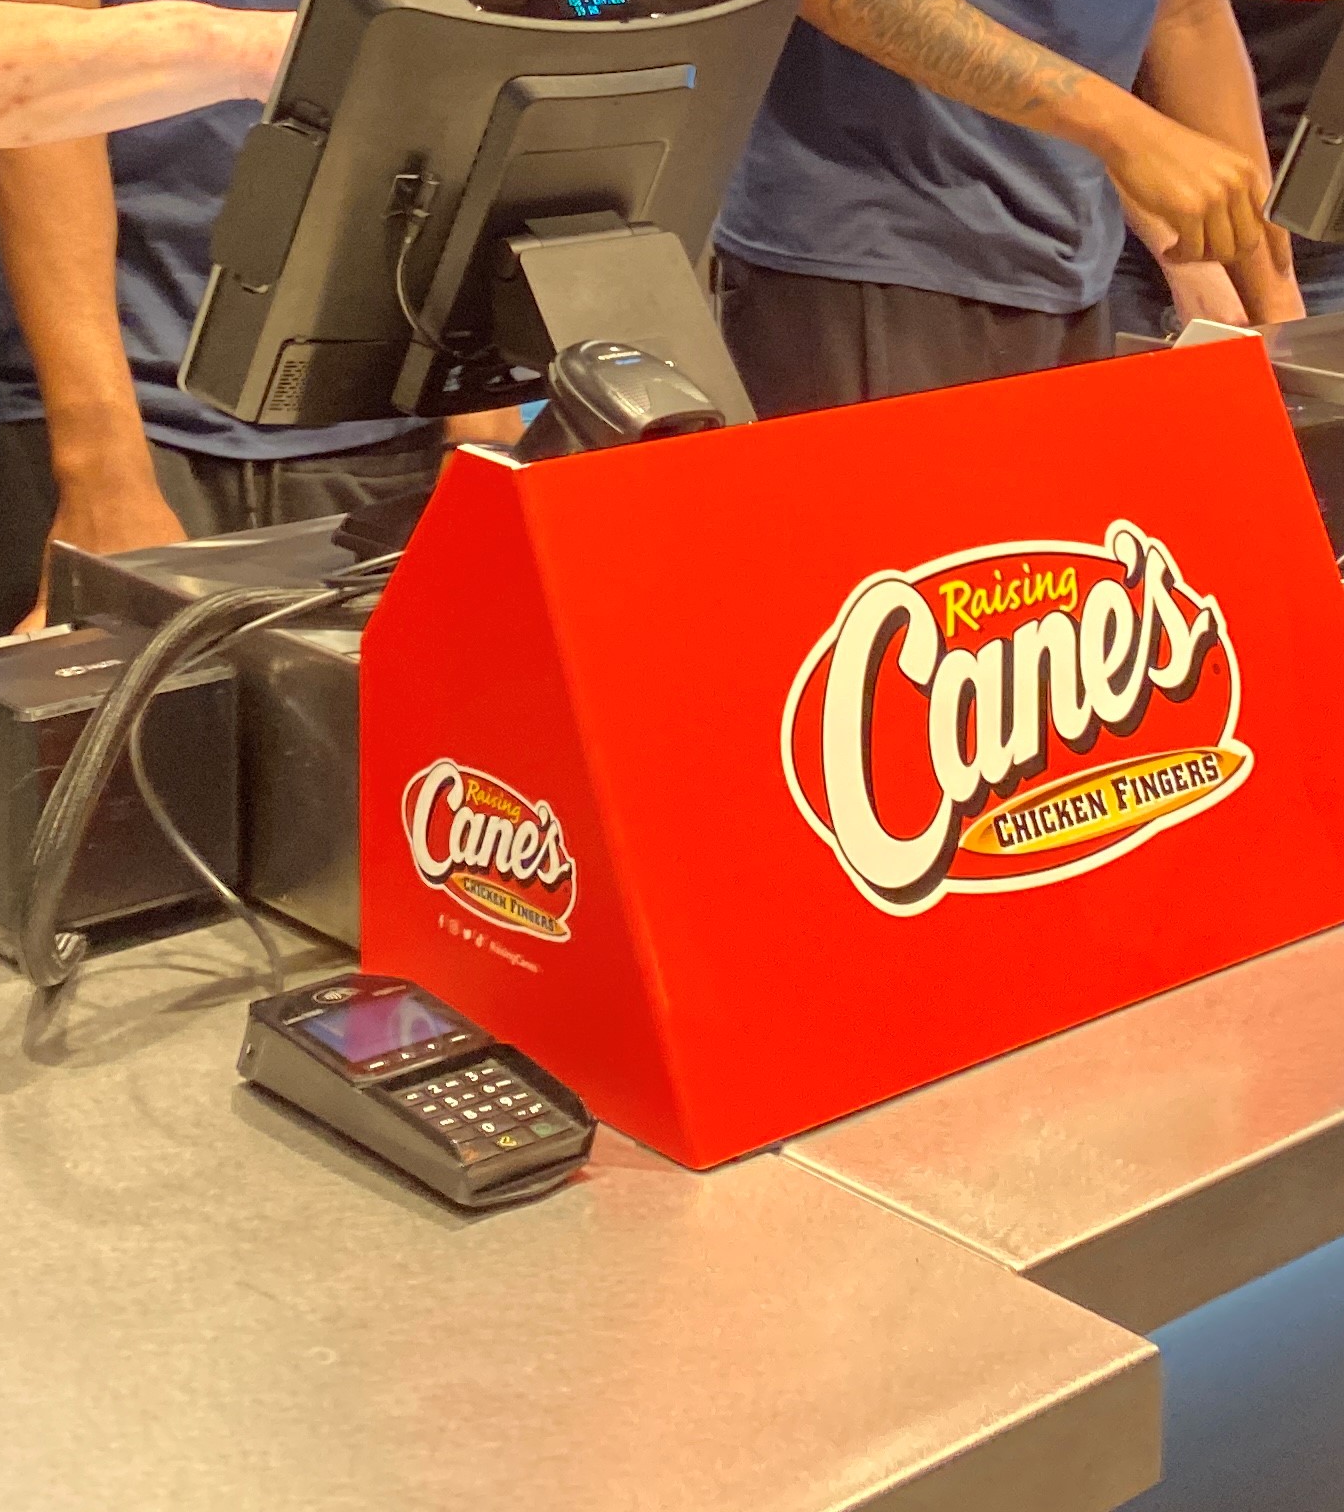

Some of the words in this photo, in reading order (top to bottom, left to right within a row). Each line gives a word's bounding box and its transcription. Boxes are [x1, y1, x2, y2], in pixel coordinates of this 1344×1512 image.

[940, 562, 1080, 639] Raising
[821, 529, 1214, 893] Cane's
[412, 761, 571, 885] Cane's
[466, 779, 522, 824] Raising
